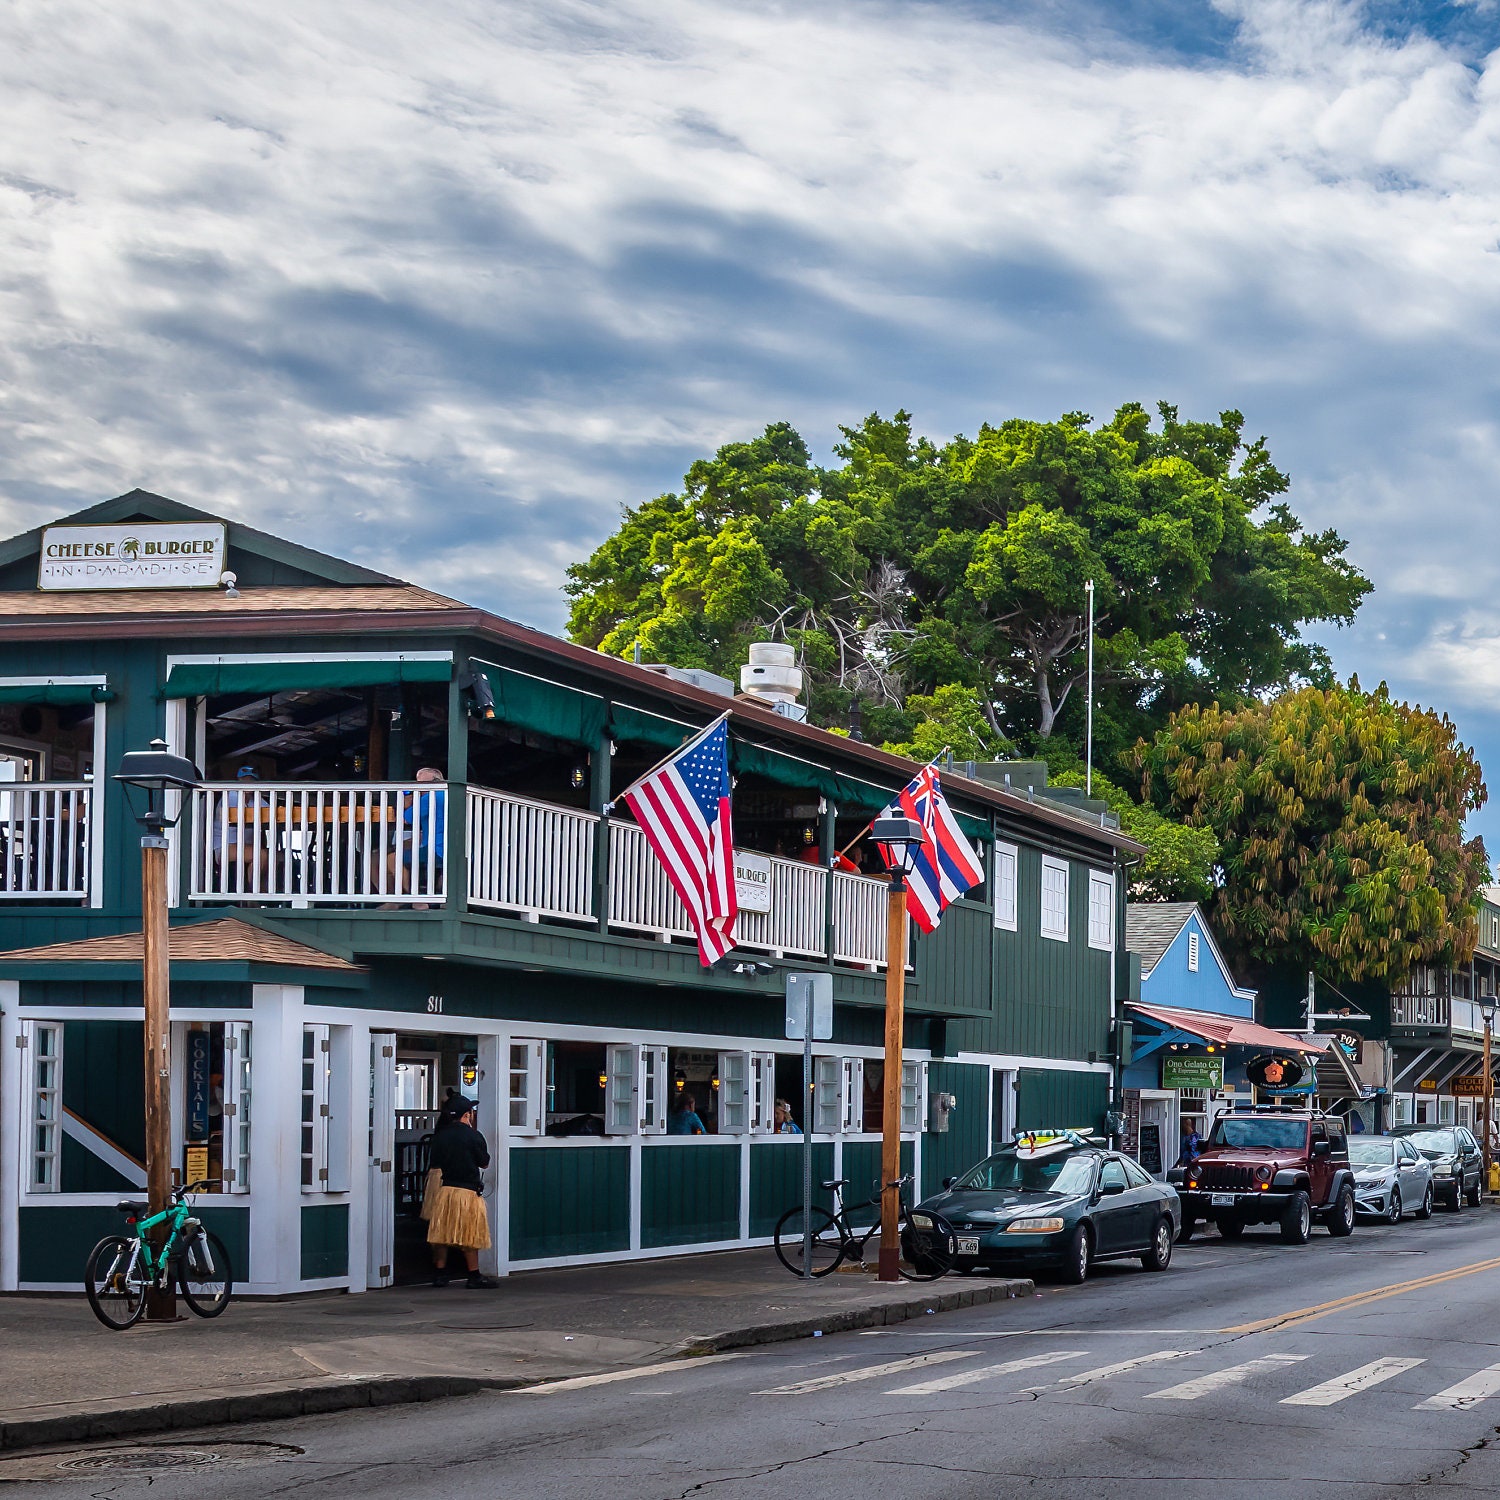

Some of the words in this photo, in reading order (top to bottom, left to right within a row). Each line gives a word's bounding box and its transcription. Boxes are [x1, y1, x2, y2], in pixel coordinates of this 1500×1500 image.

[46, 542, 115, 557] CHEESE
[144, 540, 214, 555] BURGER
[736, 866, 768, 884] BURGER
[427, 995, 443, 1013] 811
[1340, 1033, 1357, 1047] POI
[1167, 1060, 1182, 1068] Ono
[1184, 1060, 1207, 1069] Gelato
[1208, 1060, 1220, 1069] Co.
[193, 1038, 205, 1133] COCKTAILS
